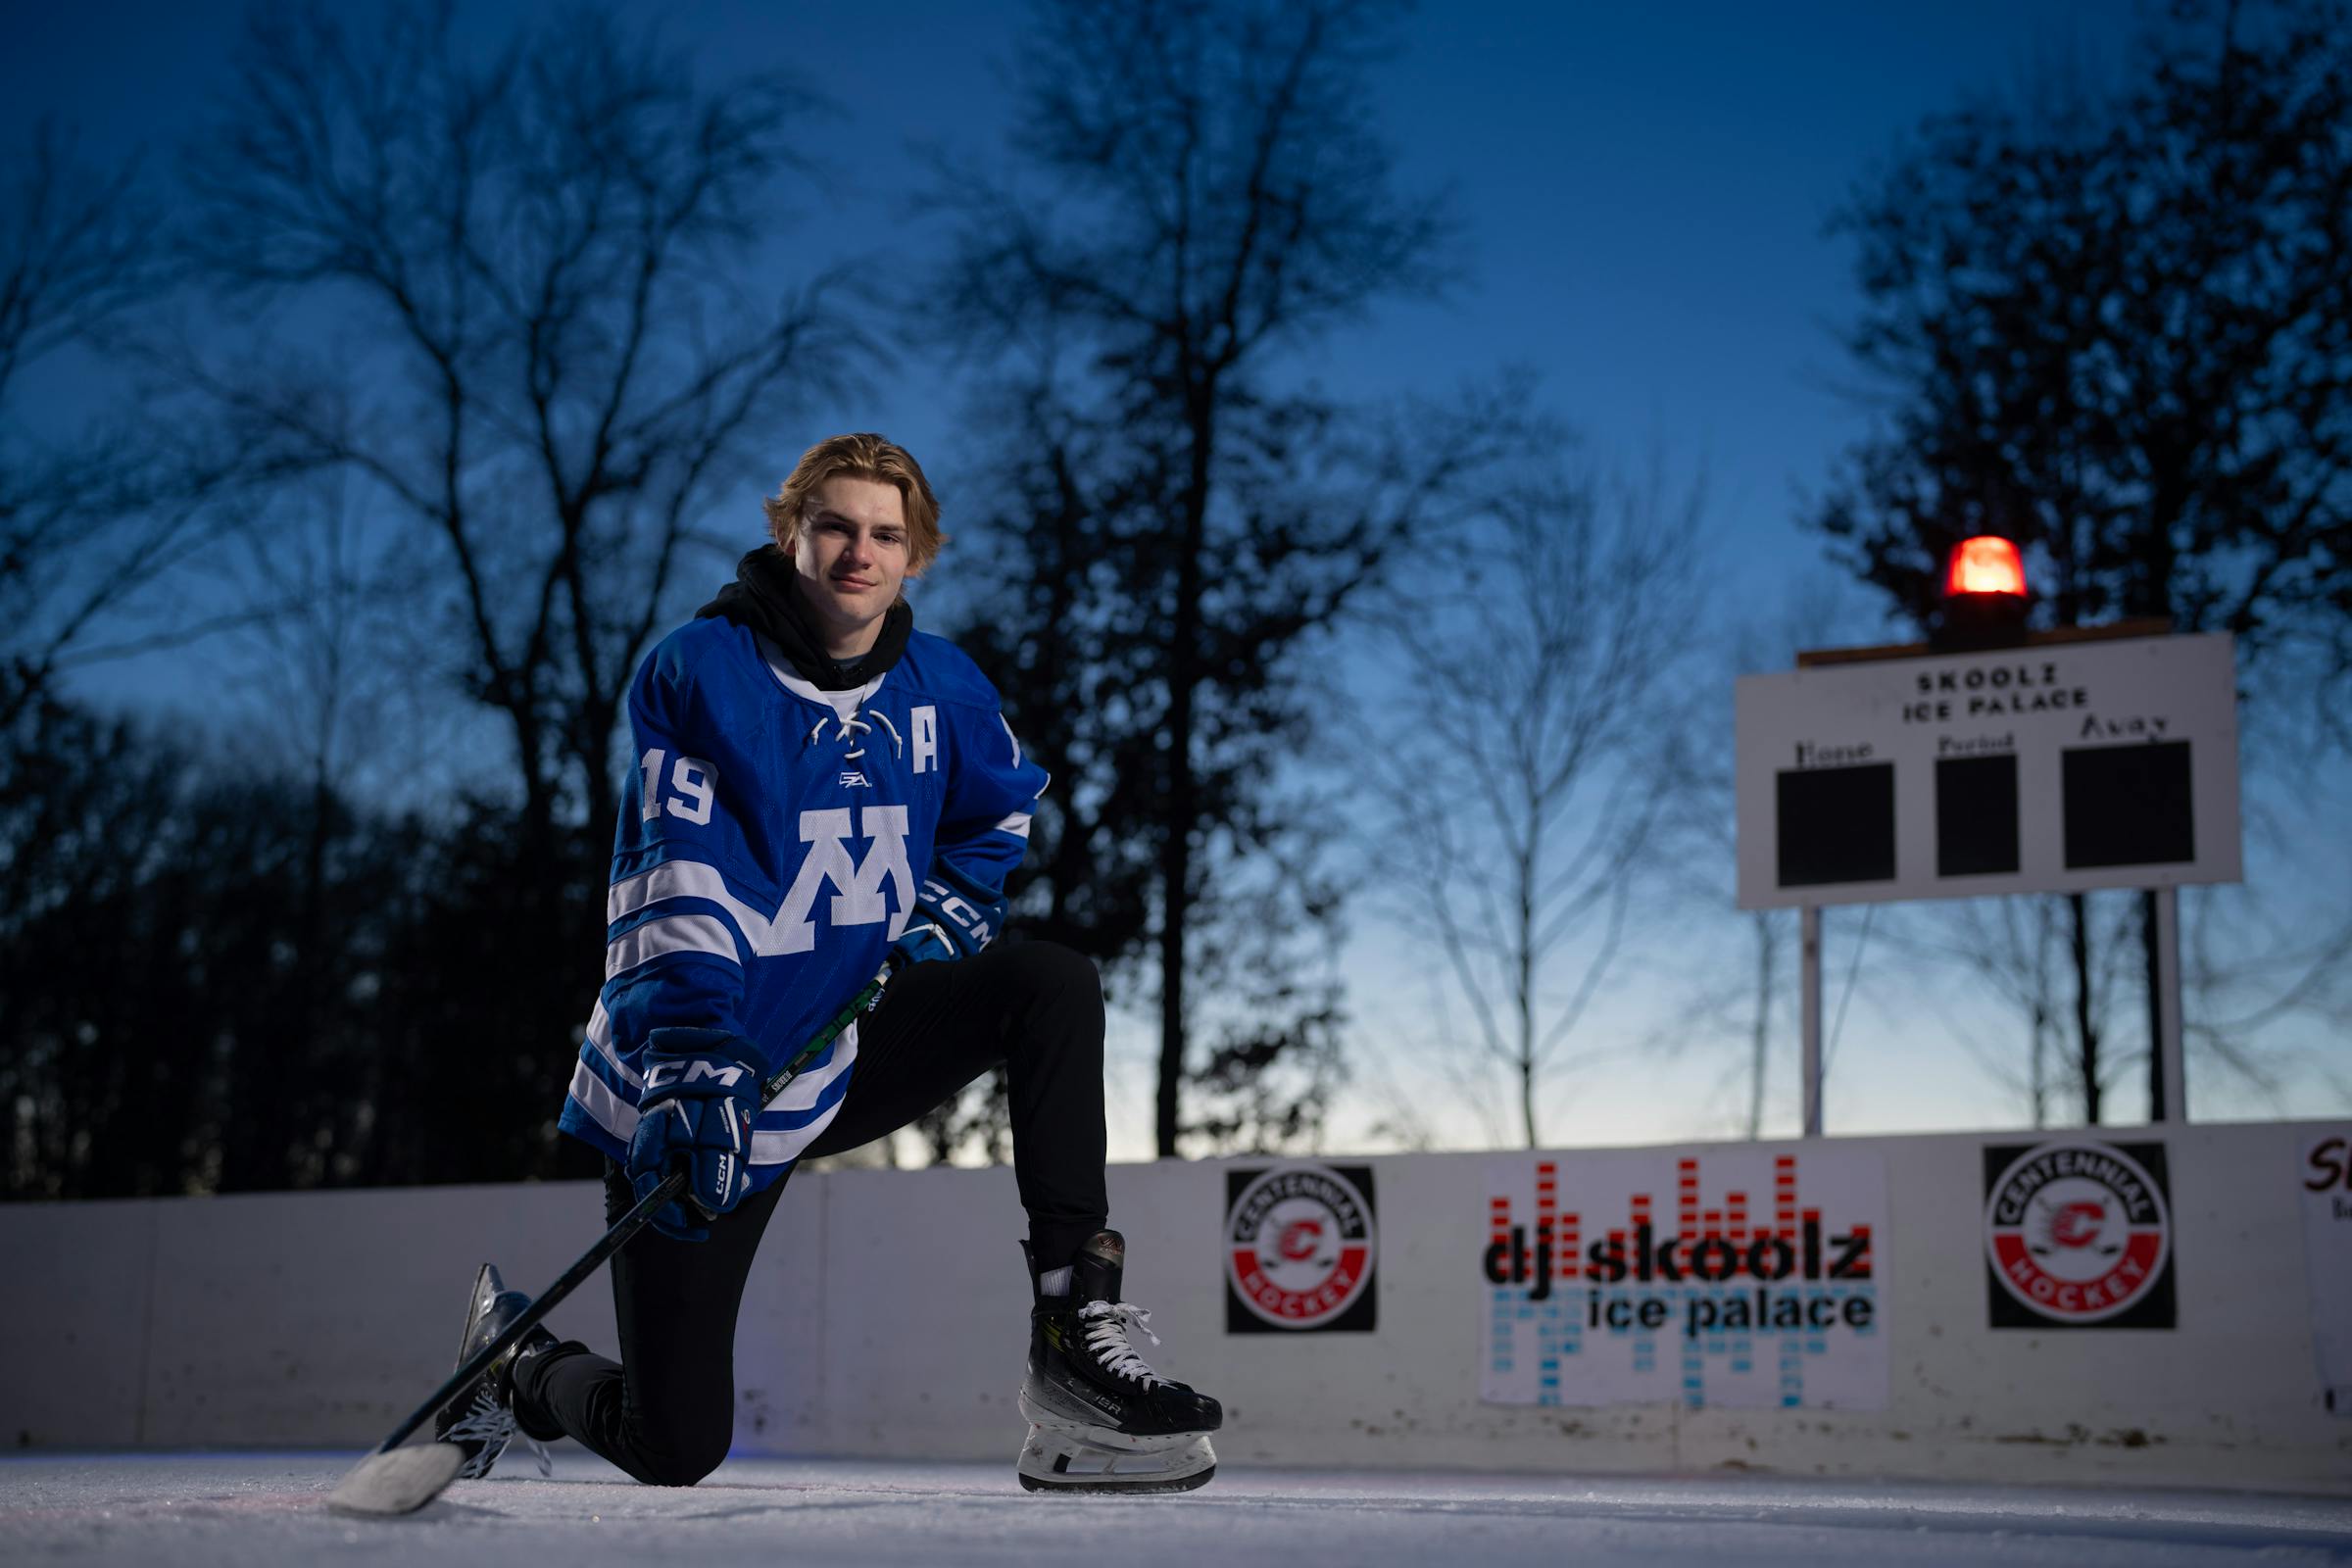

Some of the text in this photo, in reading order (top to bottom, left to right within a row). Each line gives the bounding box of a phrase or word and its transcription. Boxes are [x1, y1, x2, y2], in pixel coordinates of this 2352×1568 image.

[1916, 662, 2058, 694] SKOOLZ
[1903, 688, 2088, 724] ICE PALACE
[910, 706, 938, 774] A
[641, 748, 719, 826] 19
[757, 805, 916, 956] M
[642, 1059, 744, 1090] CM
[715, 1152, 728, 1195] CCM
[1999, 1150, 2153, 1224] CENTENNIAL
[2303, 1137, 2352, 1193] S
[1237, 1174, 1362, 1239] CENTENNIAL
[1484, 1223, 1872, 1300] dj skoolz
[2009, 1256, 2145, 1309] HOCKEY
[1245, 1267, 1352, 1317] HOCKEY
[1588, 1288, 1874, 1337] ice palace
